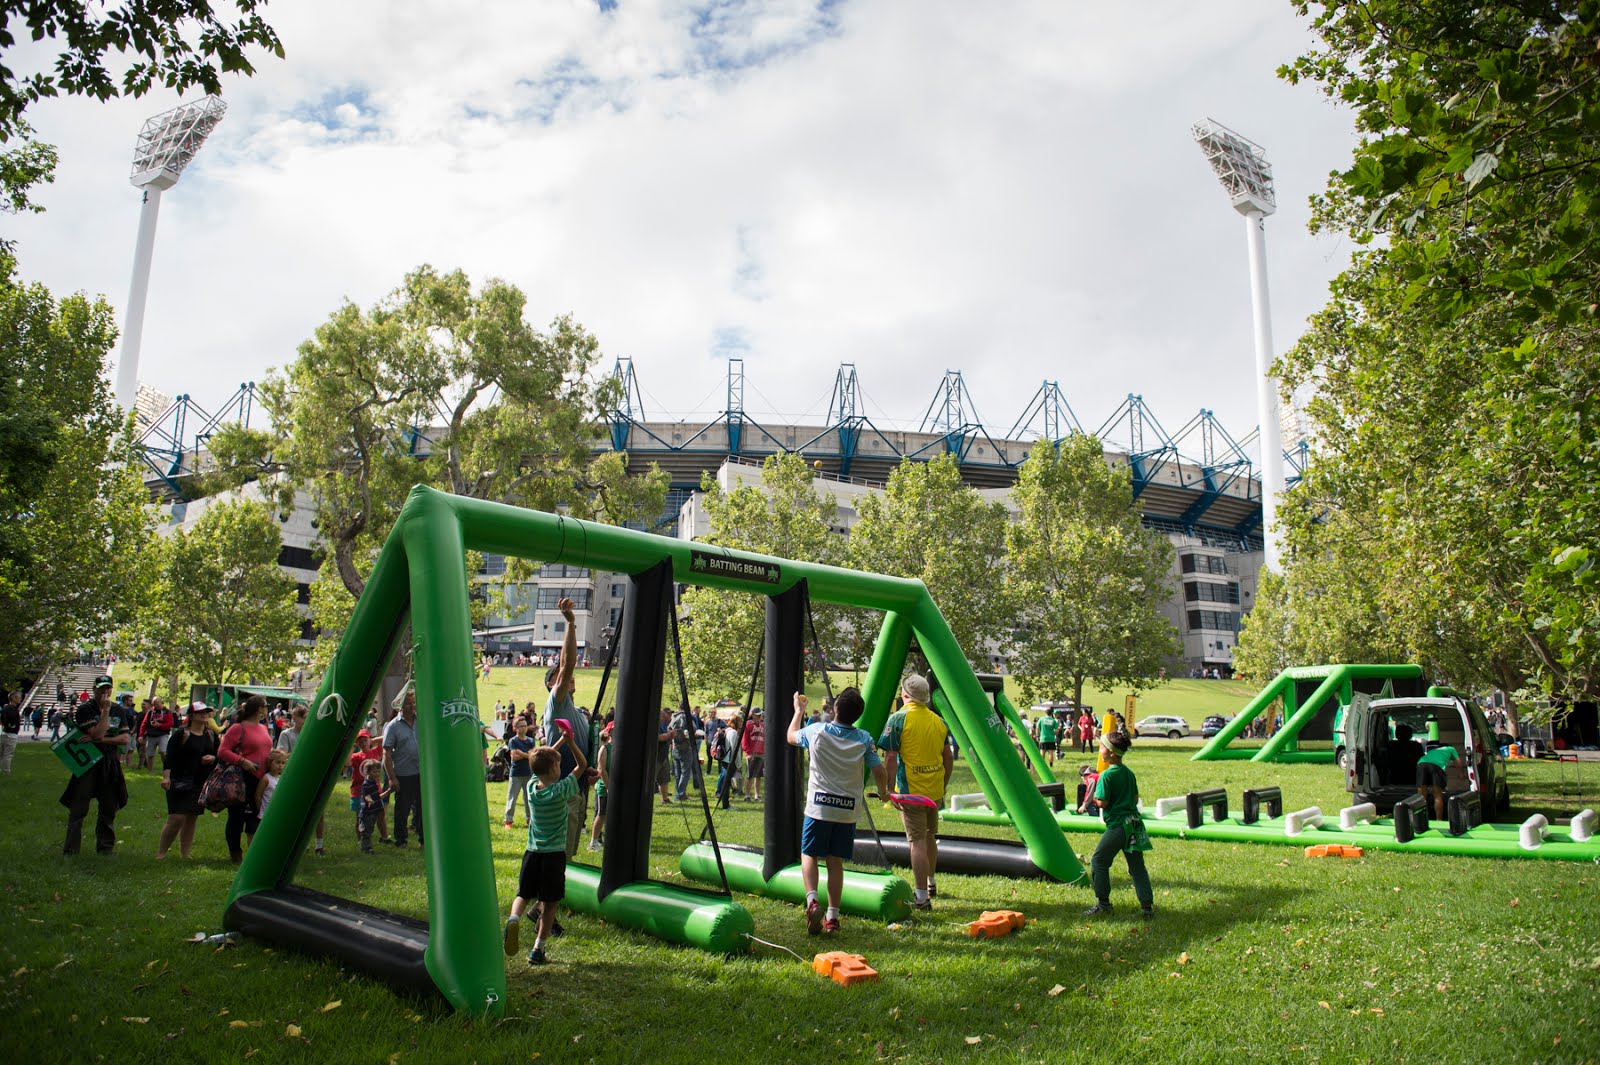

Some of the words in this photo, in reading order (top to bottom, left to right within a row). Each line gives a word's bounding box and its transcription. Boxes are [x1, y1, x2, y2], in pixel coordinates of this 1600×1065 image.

[709, 558, 743, 573] BATTING
[743, 564, 765, 576] BEAM
[64, 738, 91, 768] 6
[815, 794, 854, 807] HOSTPLUS
